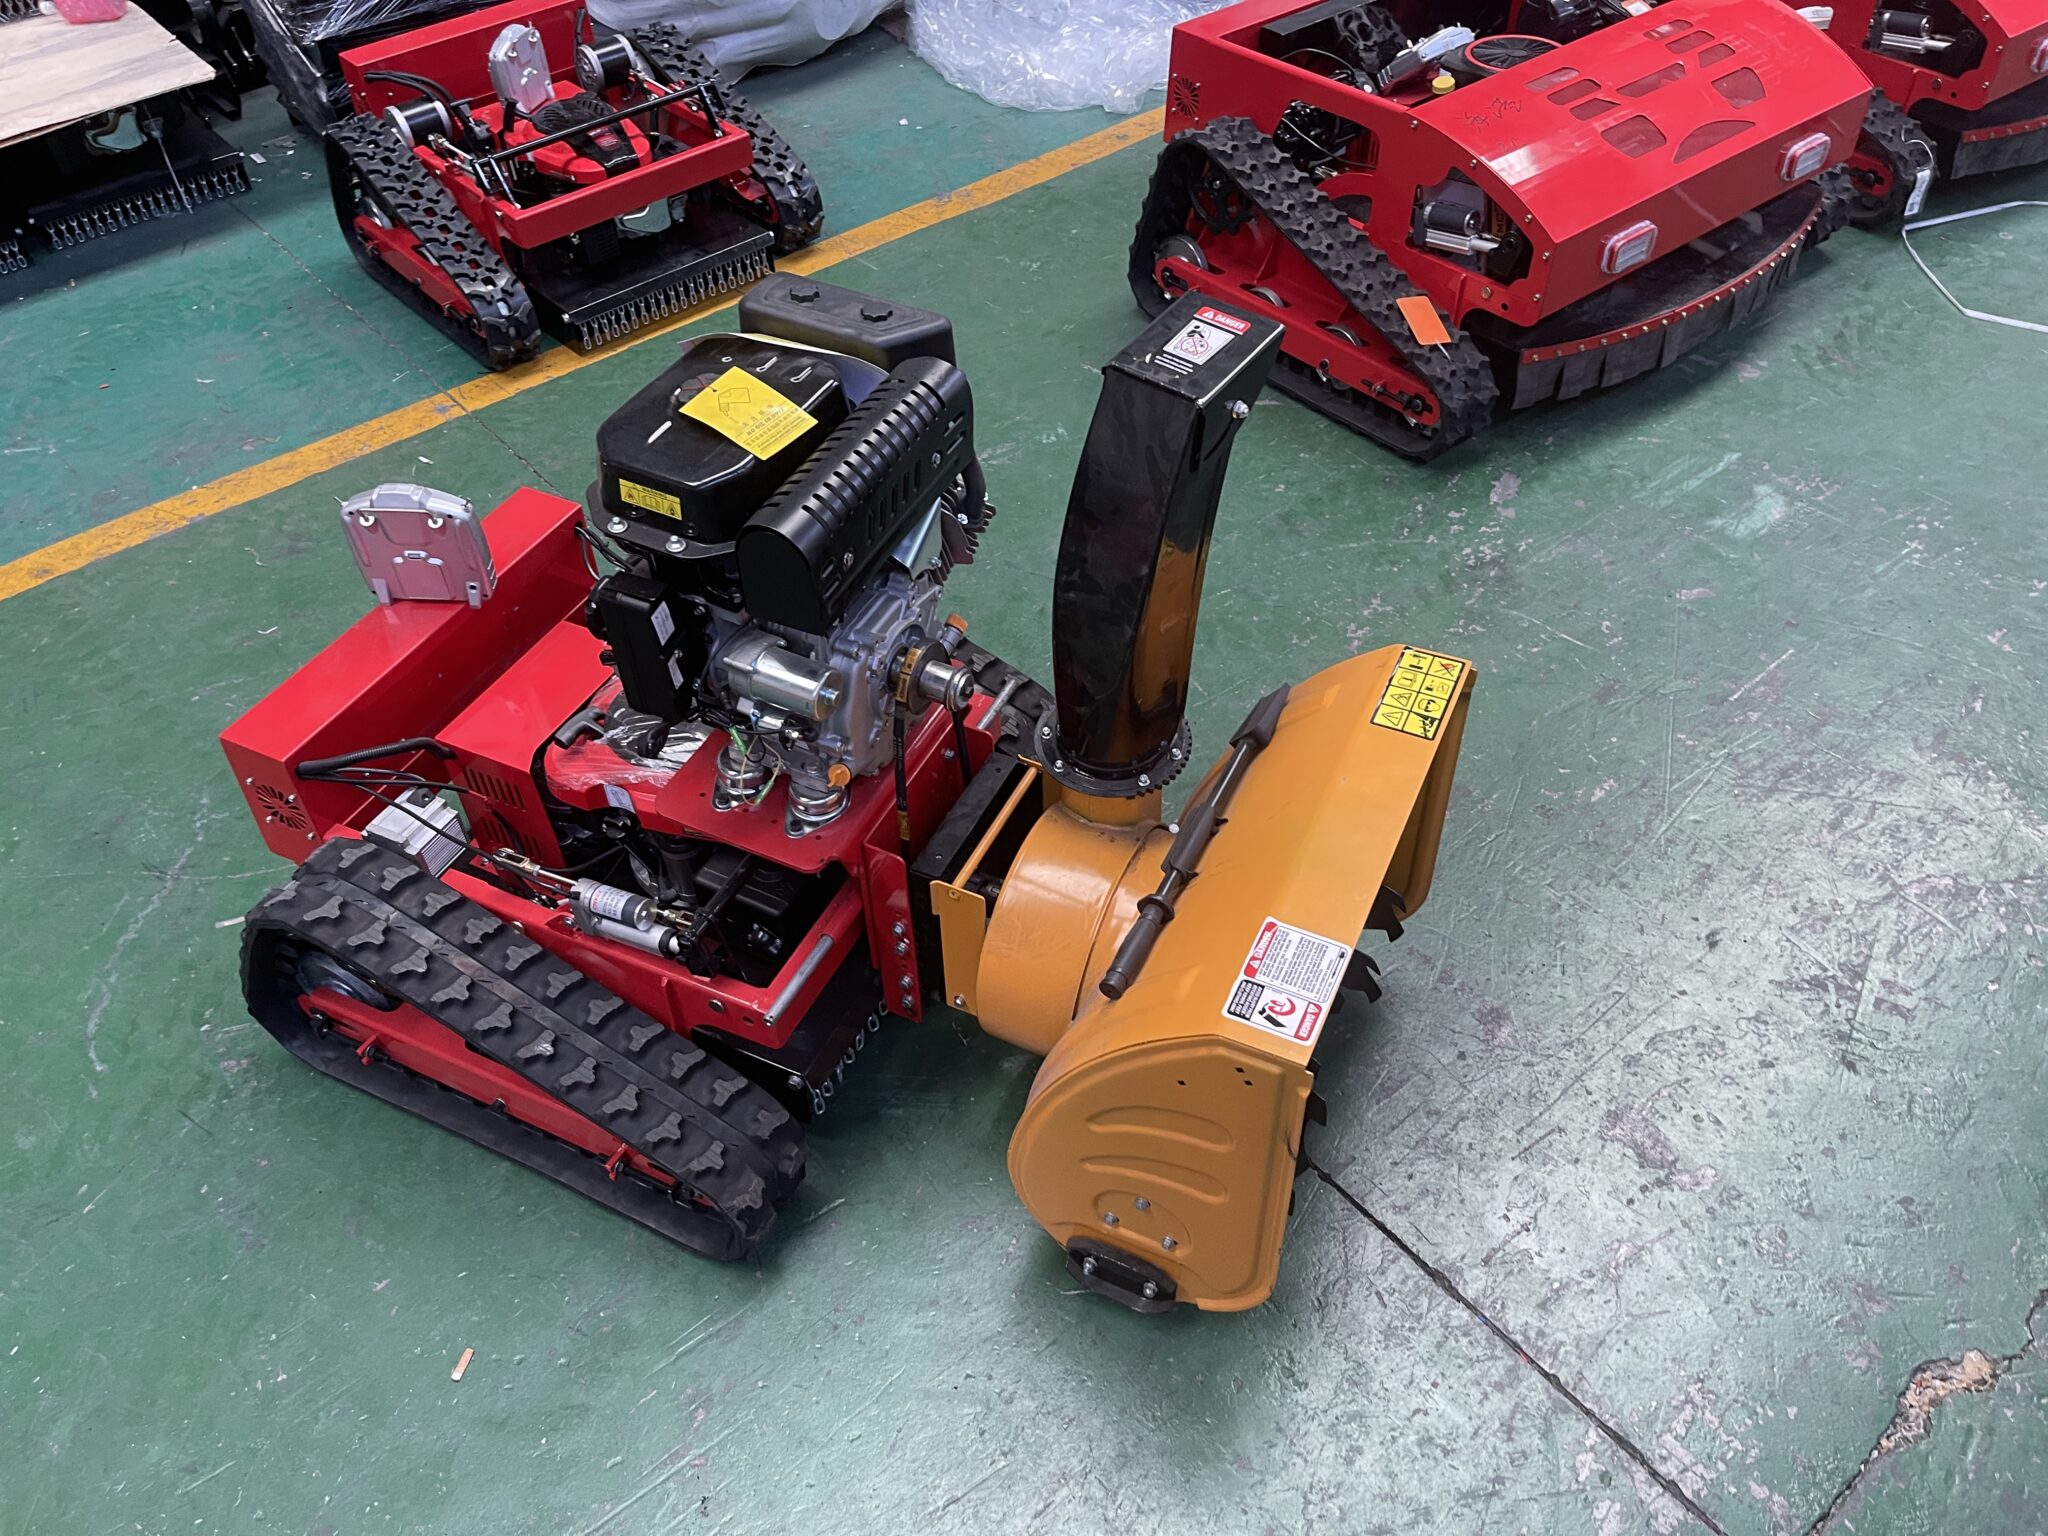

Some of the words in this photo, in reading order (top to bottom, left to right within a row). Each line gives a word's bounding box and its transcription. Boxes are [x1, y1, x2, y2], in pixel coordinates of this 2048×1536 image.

[1214, 315, 1246, 330] DANGER
[746, 427, 756, 436] NO
[755, 421, 766, 430] OIL
[1254, 931, 1273, 959] DANGER
[1299, 1012, 1315, 1037] DANGER
